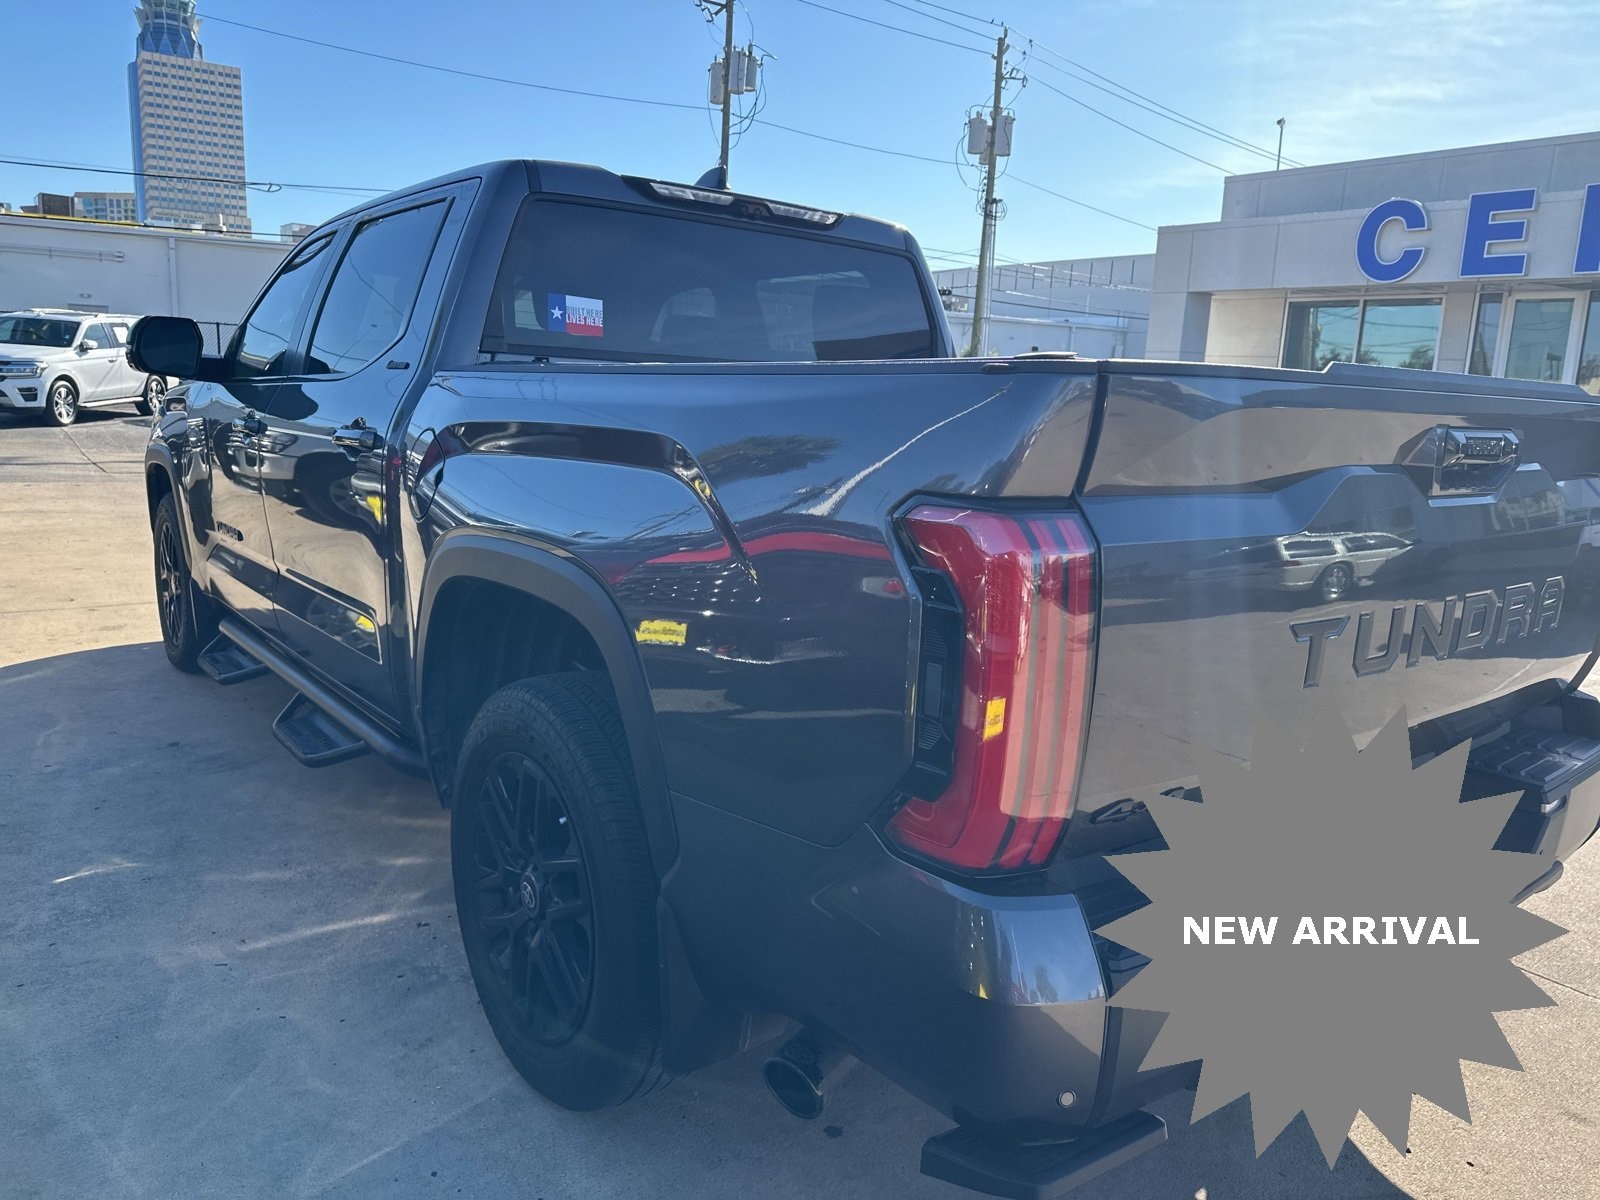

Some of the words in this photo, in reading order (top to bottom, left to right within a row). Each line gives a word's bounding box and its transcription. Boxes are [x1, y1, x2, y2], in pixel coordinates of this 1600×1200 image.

[566, 305, 586, 317] BUILT
[586, 308, 603, 319] HERE
[566, 313, 585, 325] LIVES
[586, 316, 603, 327] HERE
[1289, 575, 1565, 689] TUNDRA
